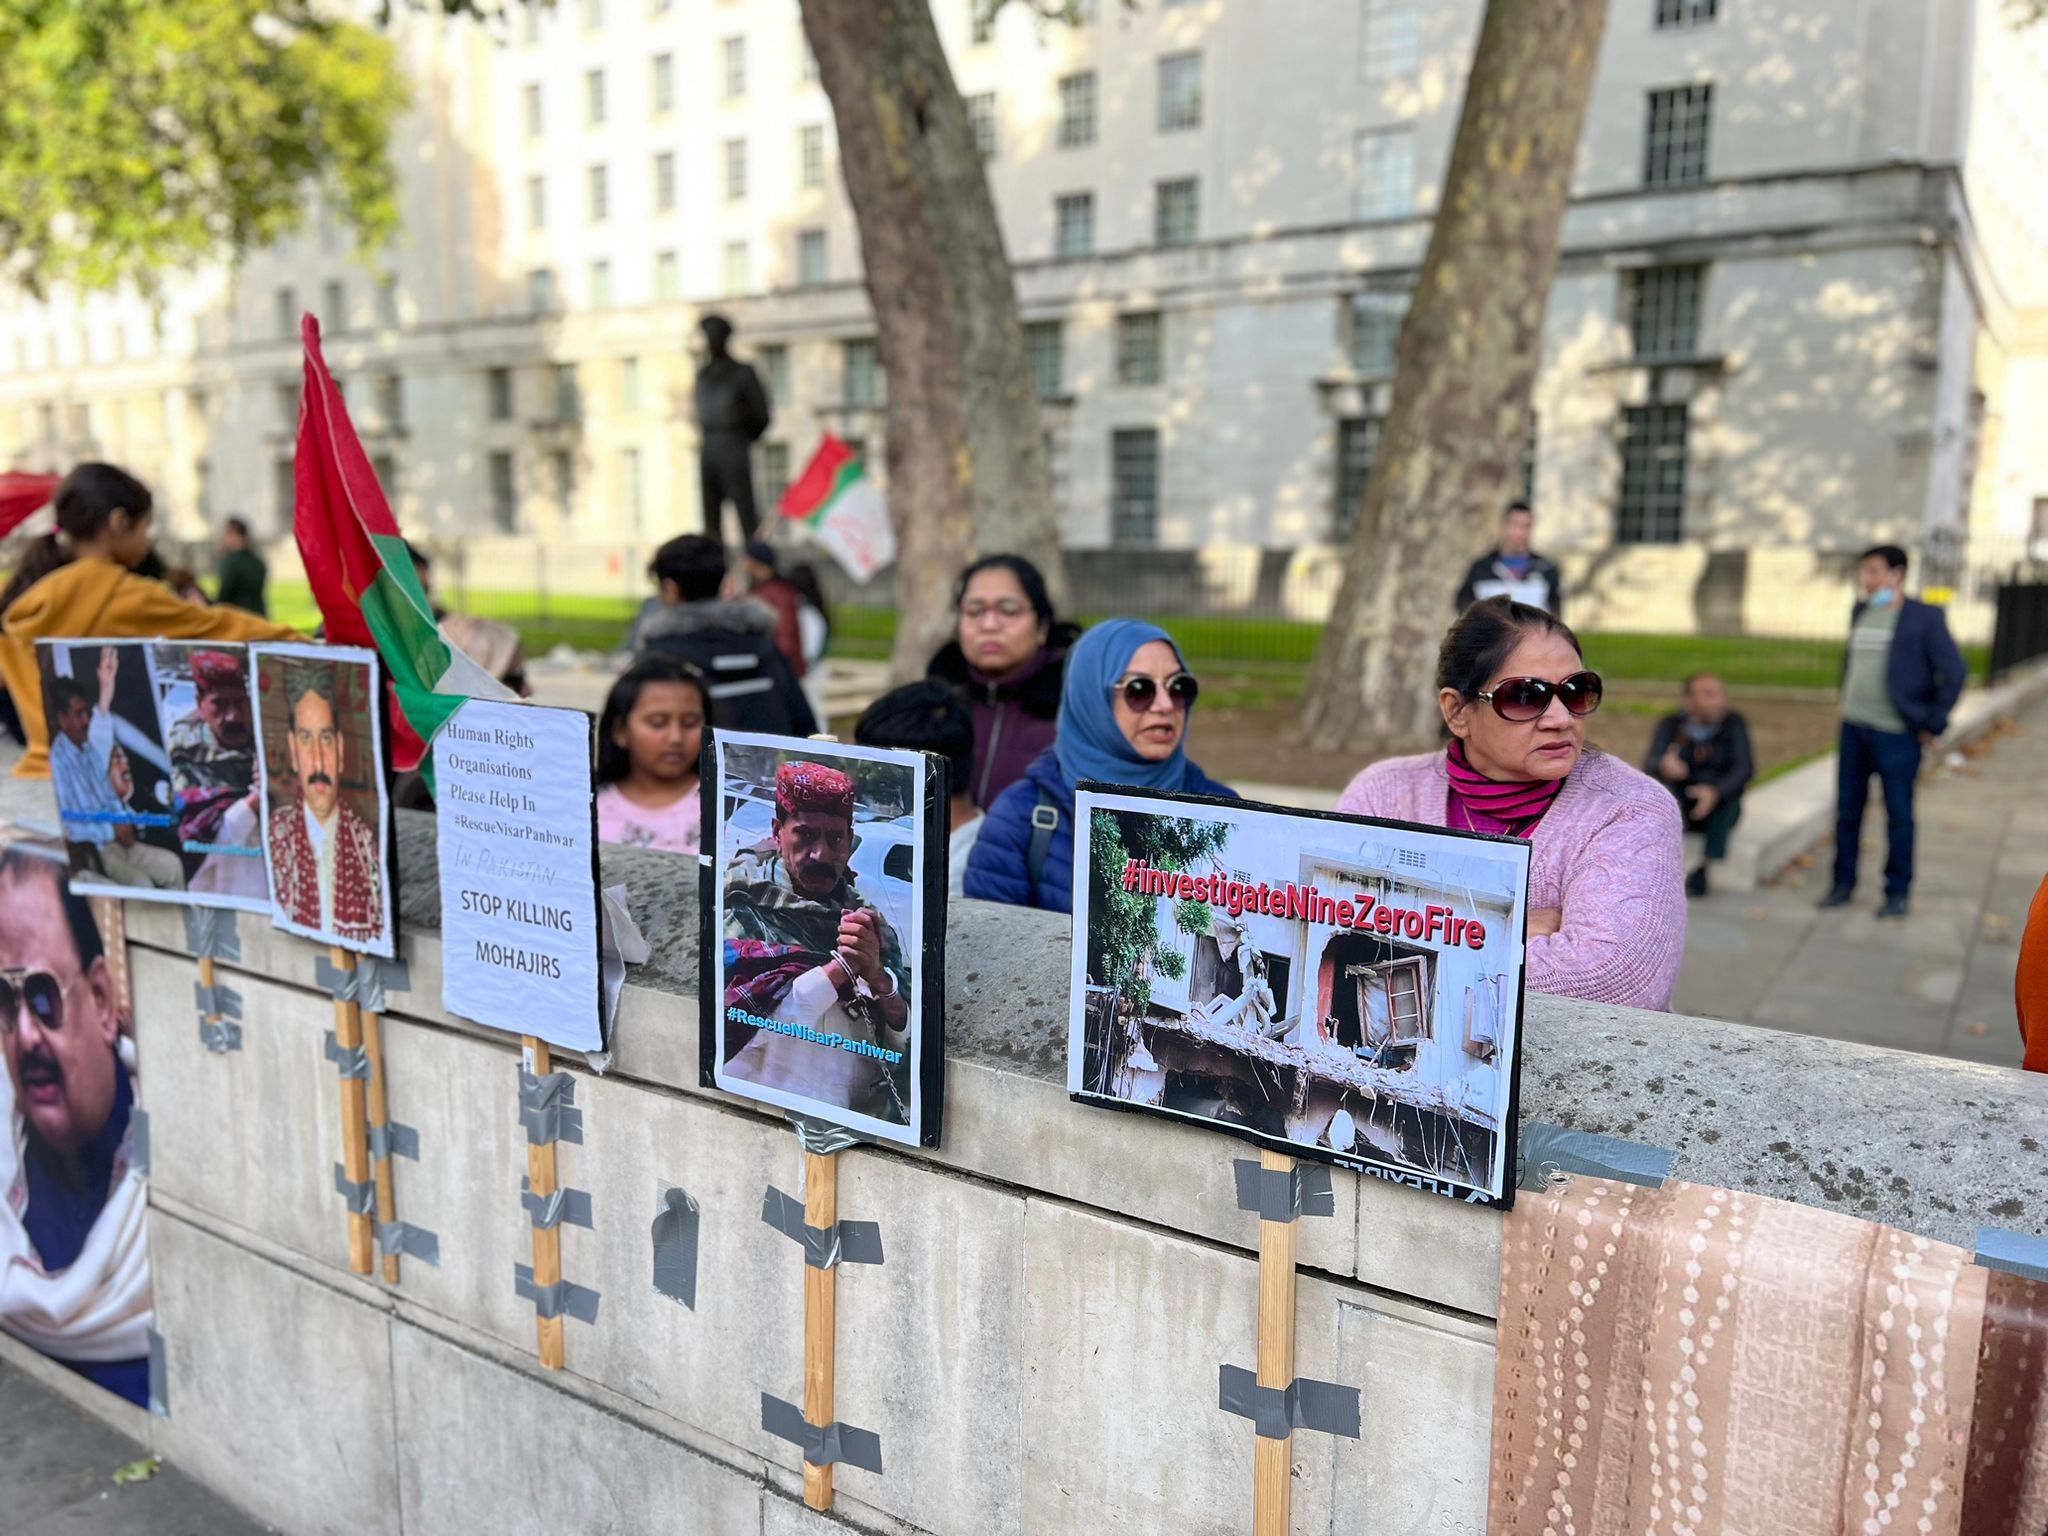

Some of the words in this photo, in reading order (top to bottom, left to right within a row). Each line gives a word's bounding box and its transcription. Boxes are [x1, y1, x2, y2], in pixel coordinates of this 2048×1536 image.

[447, 722, 491, 743] Human
[495, 728, 535, 750] Rights
[448, 753, 532, 780] Organisations
[451, 783, 486, 804] Please
[489, 790, 519, 813] Help
[522, 795, 536, 812] In
[454, 814, 575, 847] #RescueNisarPanhwar
[475, 847, 557, 887] PAKISTAN
[460, 889, 502, 916] STOP
[506, 898, 573, 932] KILLING
[1121, 857, 1485, 950] #investigateNineZeroFire
[476, 940, 561, 979] MOHAJIRS
[726, 1006, 903, 1065] #RescueNisarPanhwar
